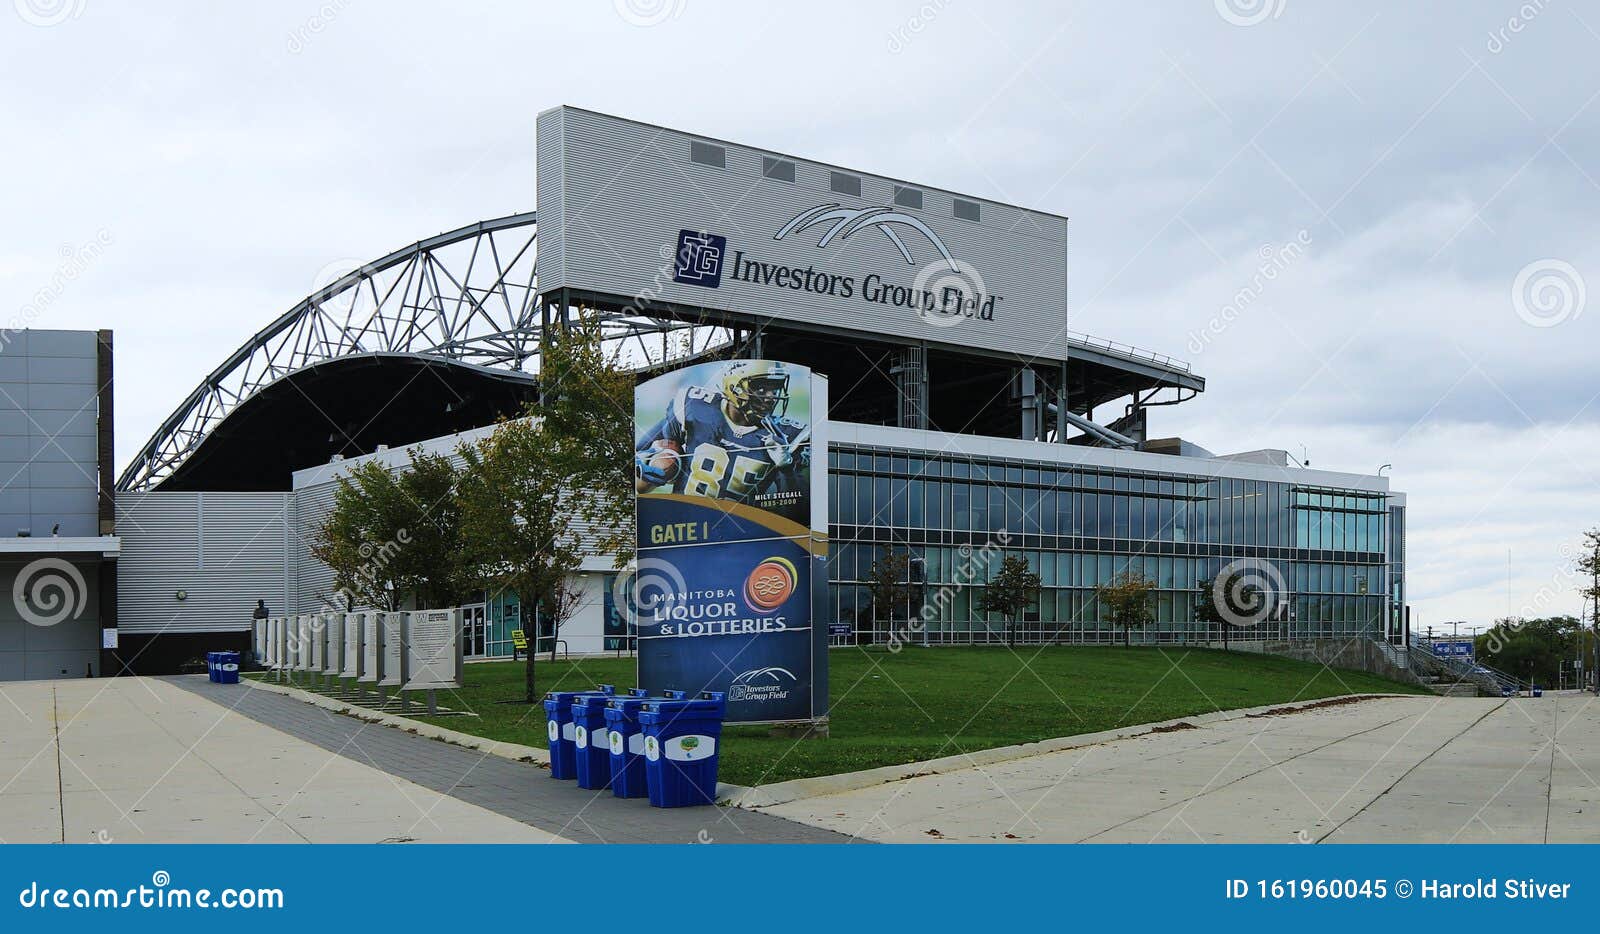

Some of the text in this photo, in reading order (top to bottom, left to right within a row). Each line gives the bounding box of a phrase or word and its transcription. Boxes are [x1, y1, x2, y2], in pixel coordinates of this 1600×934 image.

[730, 250, 998, 322] Investors Group Field
[773, 491, 802, 499] STEGALL
[651, 522, 697, 544] GATE
[654, 589, 736, 602] MANITOBA
[654, 602, 737, 621] LIQUOR
[660, 617, 787, 637] & LOTTERIES
[745, 690, 787, 701] Group Field
